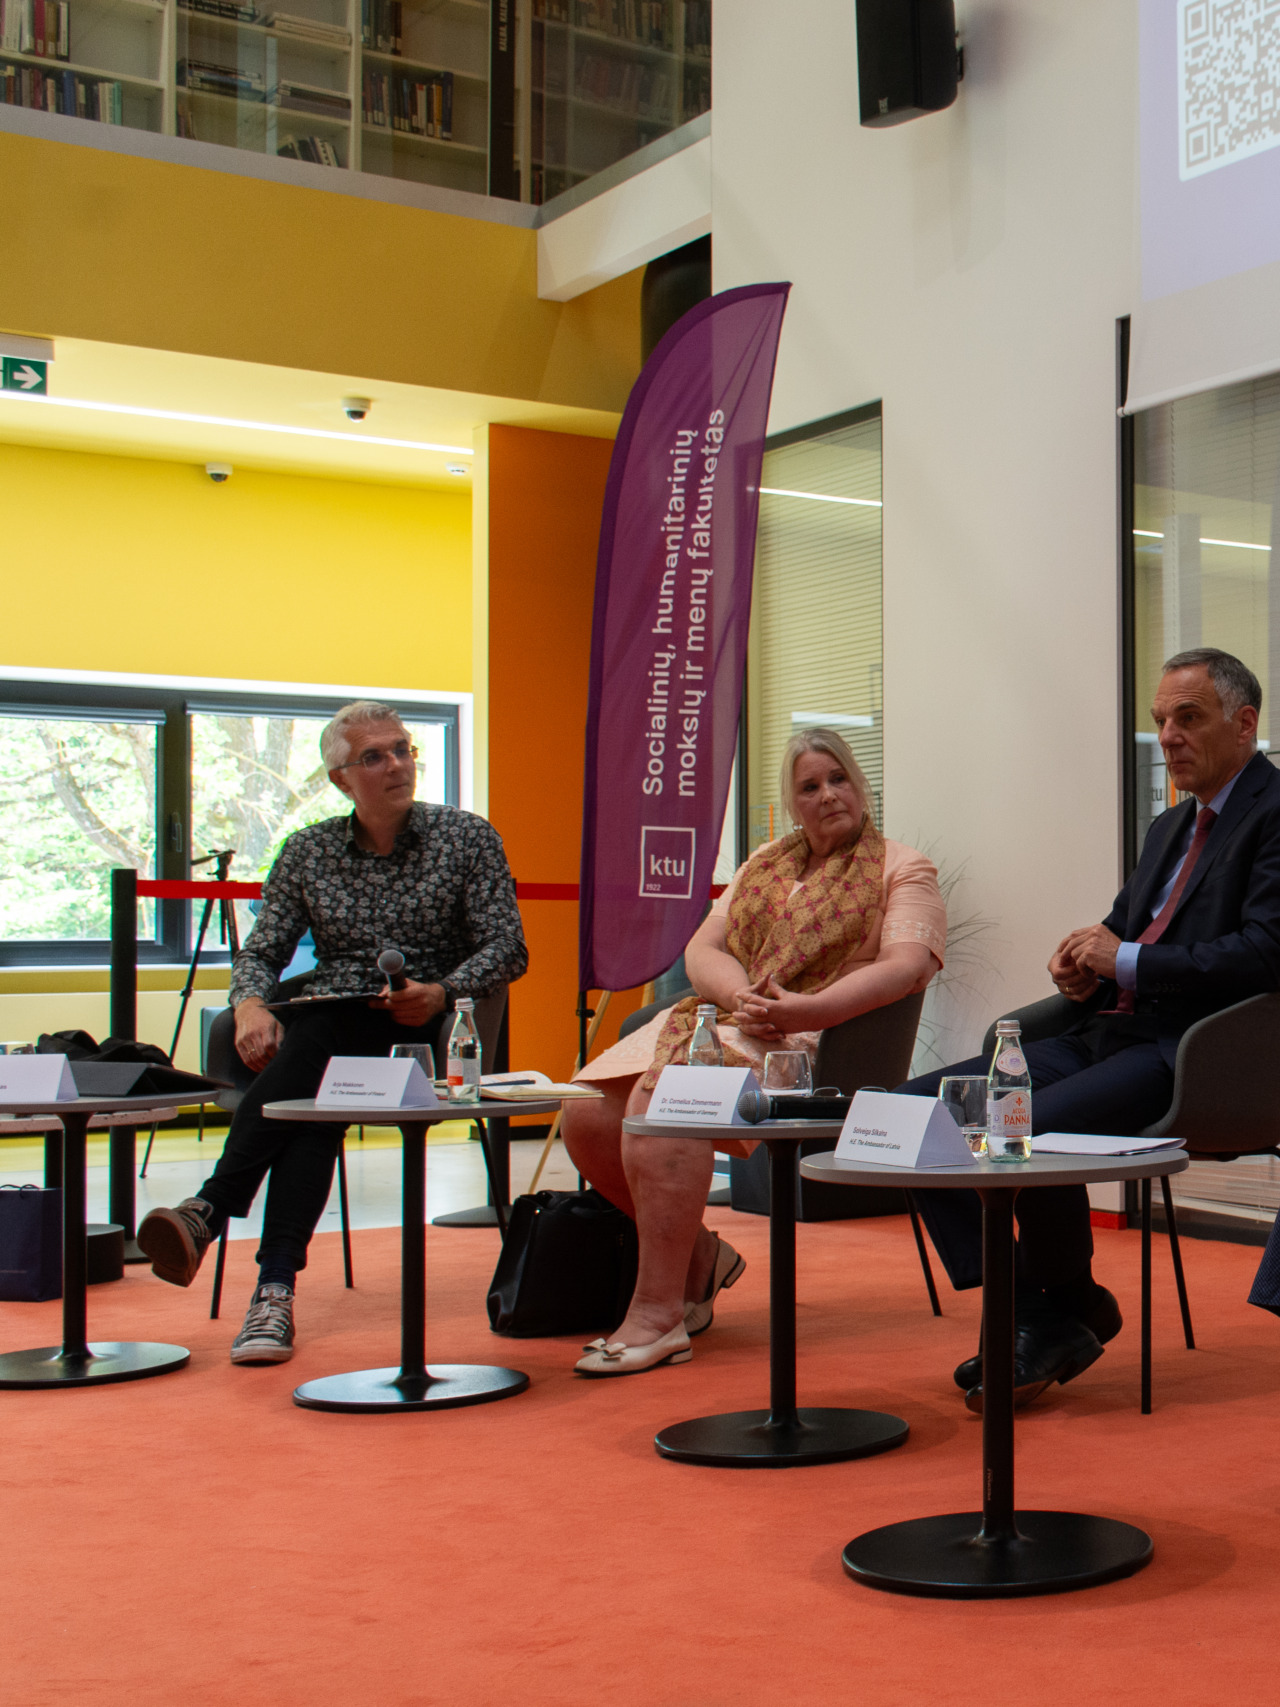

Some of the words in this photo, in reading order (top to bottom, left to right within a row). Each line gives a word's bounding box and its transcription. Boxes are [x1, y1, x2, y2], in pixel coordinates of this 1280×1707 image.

[687, 409, 725, 559] fakultetas
[652, 430, 698, 633] humanitarinių
[687, 568, 713, 651] menų
[679, 660, 704, 680] ir
[643, 644, 677, 796] Socialinių,
[677, 690, 706, 796] mokslų
[646, 883, 661, 891] 1922
[650, 854, 685, 877] ktu
[1004, 1115, 1030, 1126] PANNA
